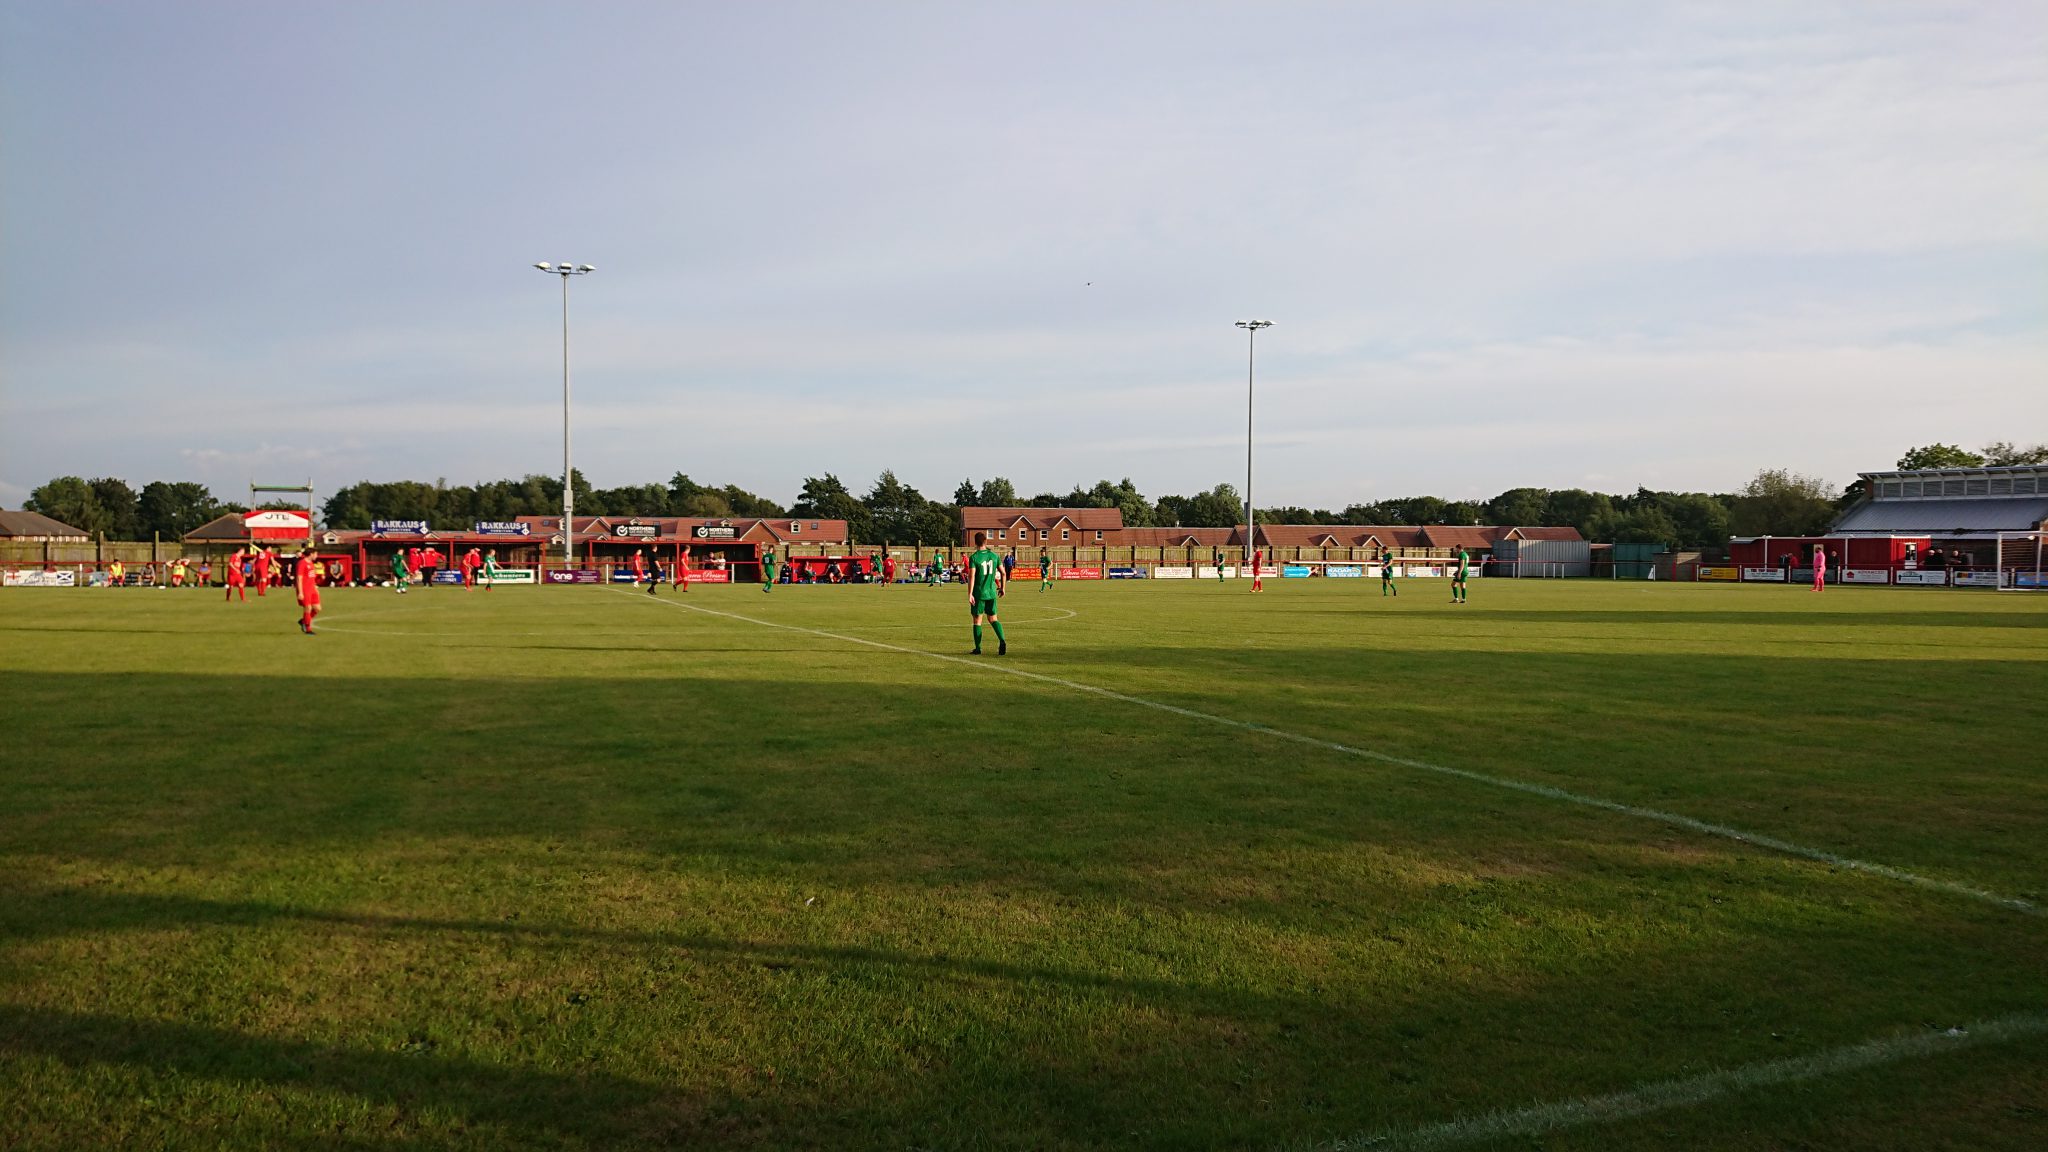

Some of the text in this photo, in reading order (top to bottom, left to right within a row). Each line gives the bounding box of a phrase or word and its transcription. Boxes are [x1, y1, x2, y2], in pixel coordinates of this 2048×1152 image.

[377, 520, 418, 529] RAKKAUS
[481, 521, 521, 530] RAKKAUS
[981, 559, 994, 576] 11
